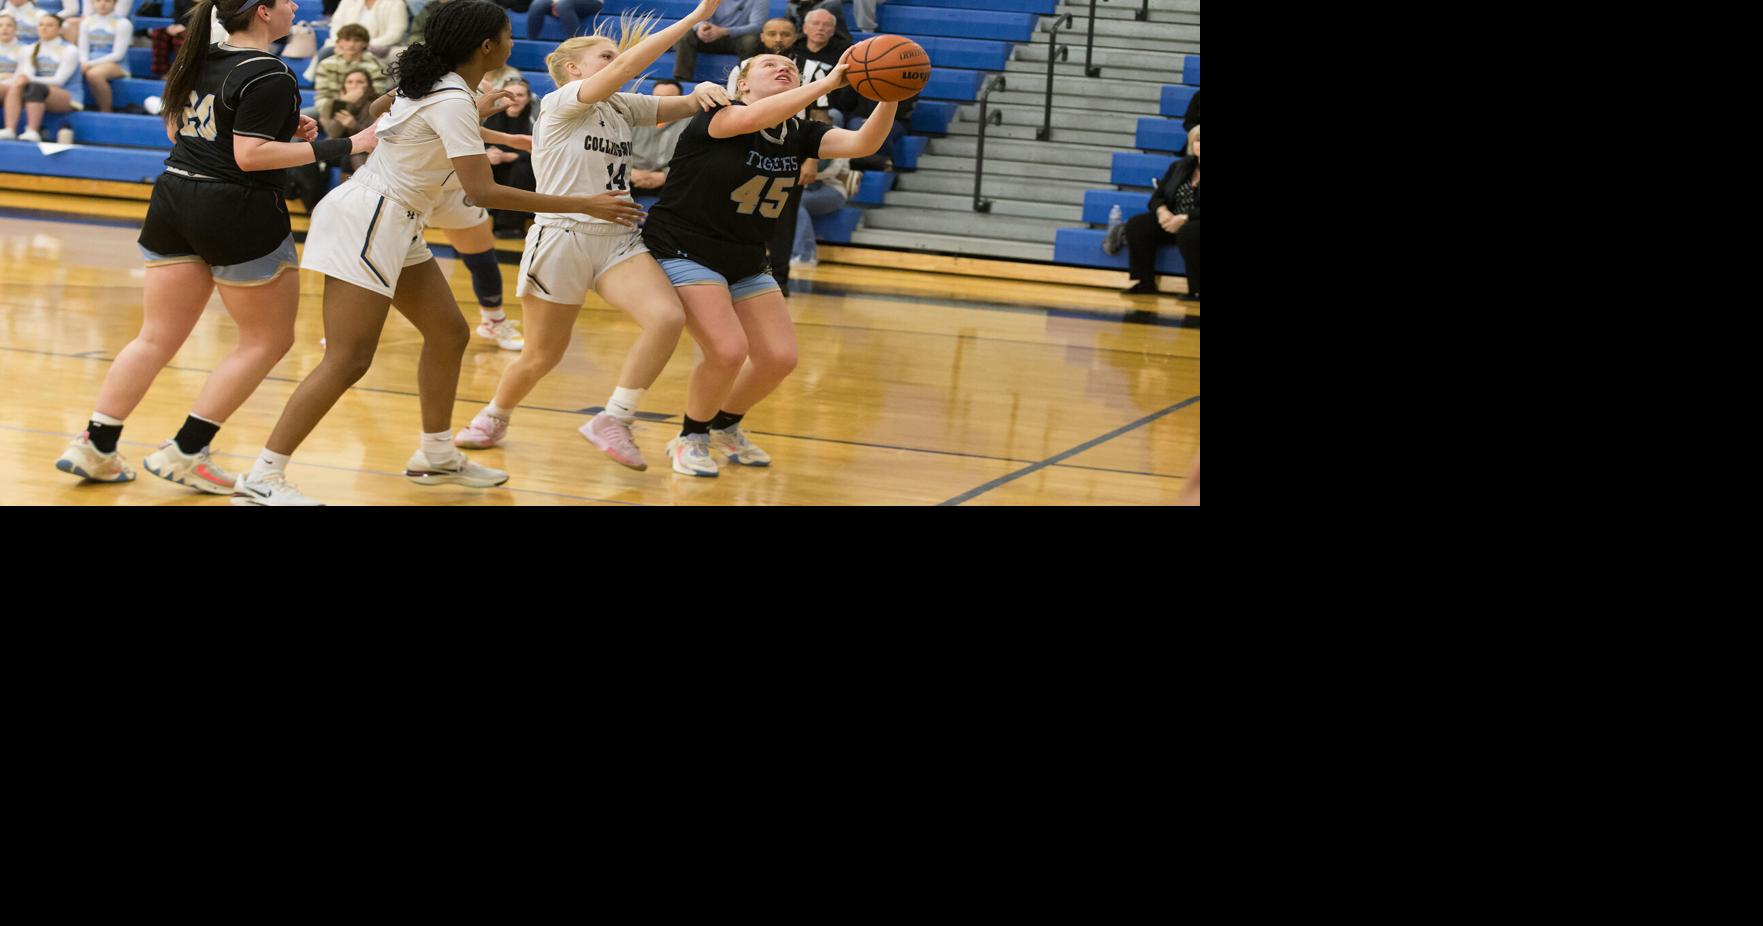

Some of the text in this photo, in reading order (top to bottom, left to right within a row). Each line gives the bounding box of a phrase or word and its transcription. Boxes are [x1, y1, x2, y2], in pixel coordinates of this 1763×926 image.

[746, 150, 798, 172] TIGERS
[606, 163, 627, 190] 14
[730, 175, 796, 219] 45
